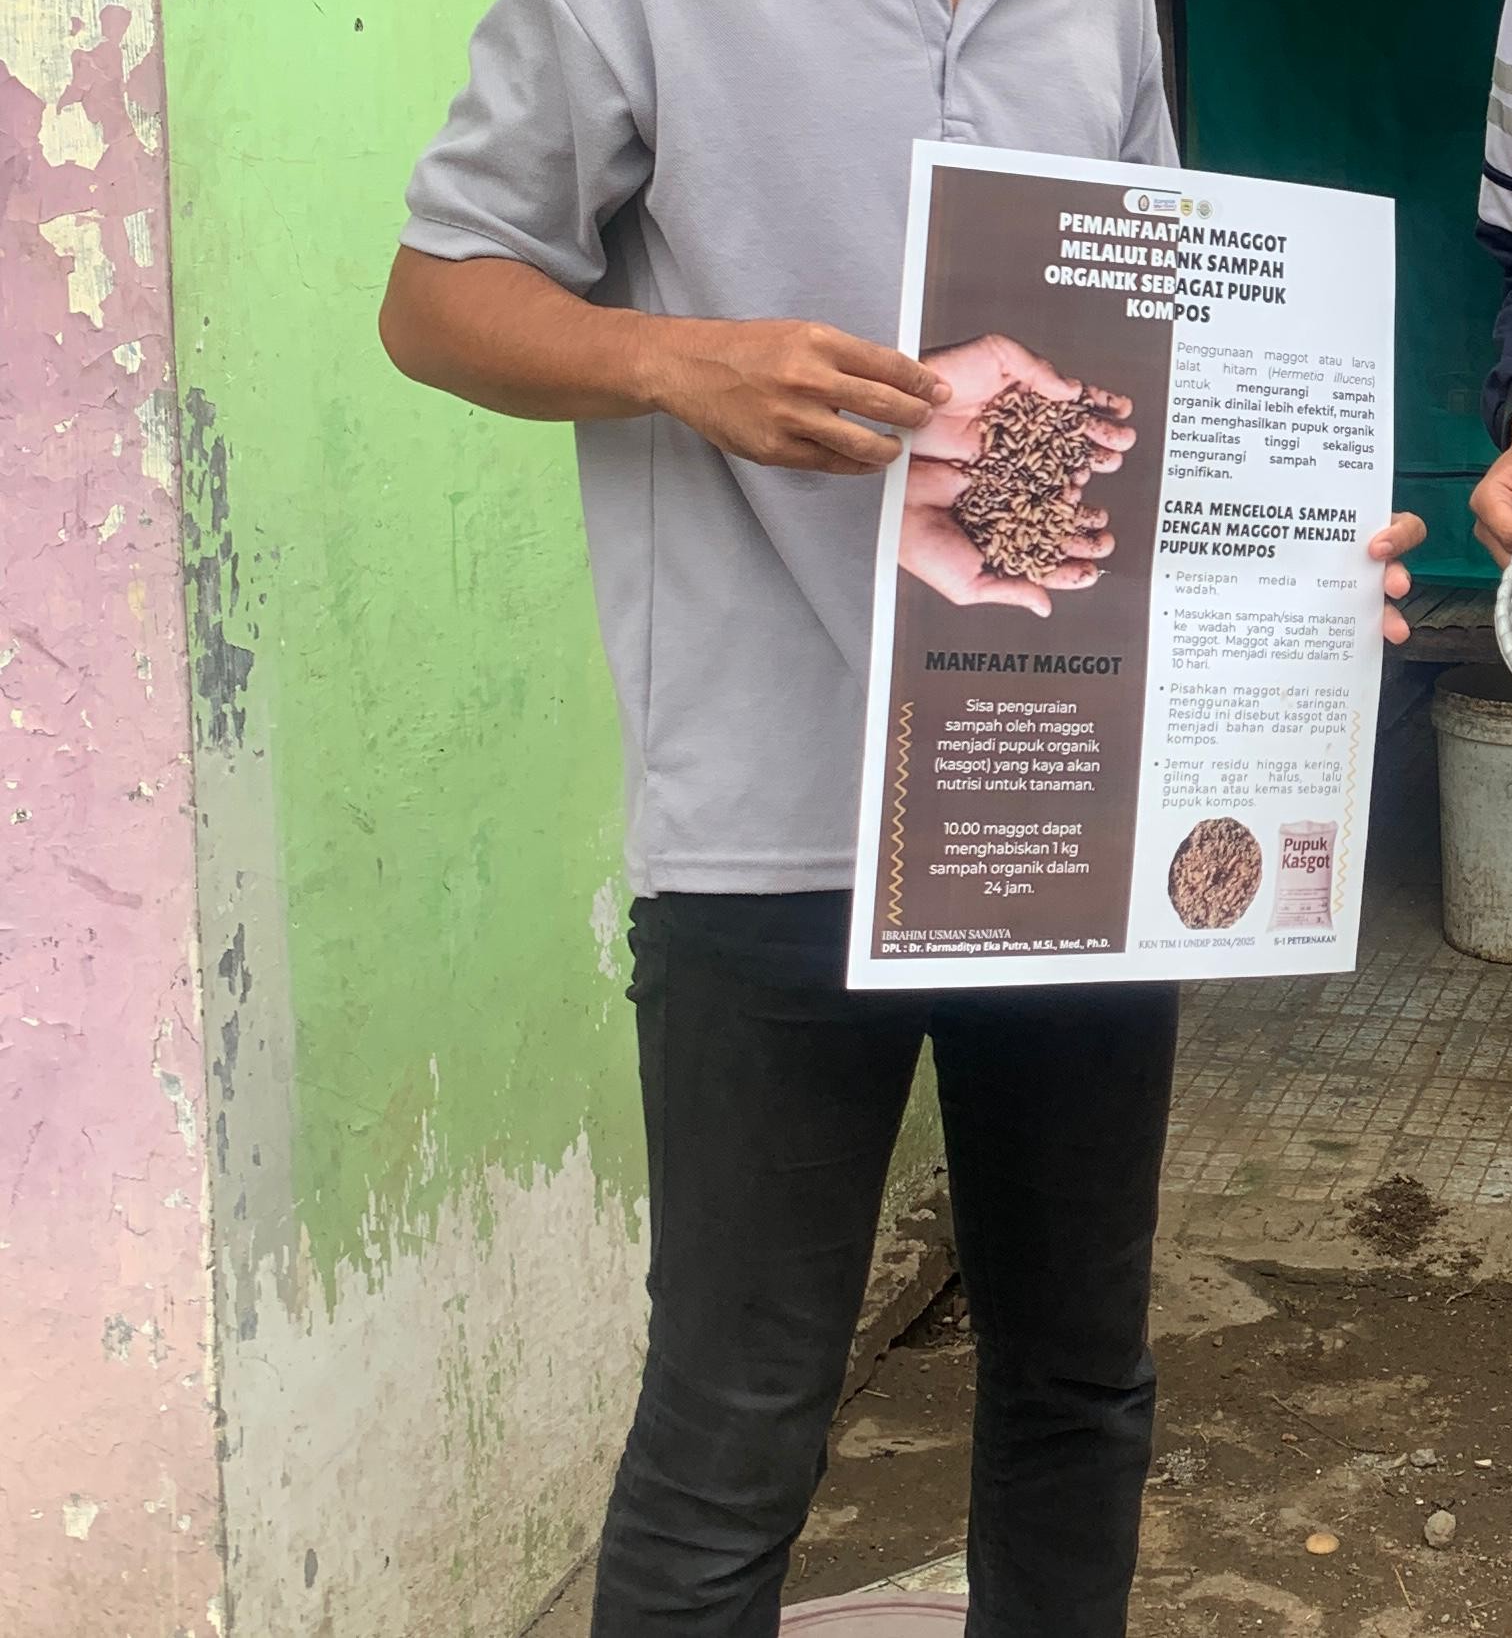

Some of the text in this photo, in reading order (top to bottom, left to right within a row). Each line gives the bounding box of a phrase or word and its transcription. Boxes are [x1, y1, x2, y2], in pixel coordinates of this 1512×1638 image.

[1059, 212, 1286, 253] PEMANFAATAN MAGGOT
[1061, 240, 1284, 278] MELALUI BANK SAMPAH
[1045, 265, 1286, 305] ORGANIK SEBAGAI PUPUK
[1126, 298, 1211, 323] KOMPOS
[1177, 342, 1375, 369] Penggunaan maggot atau larva
[1176, 360, 1375, 388] lalat hitam (Hermetia illucens)
[1175, 379, 1375, 404] untuk mengurangi sampah
[1174, 397, 1374, 419] organik dinilai lebih efektif, murah
[1172, 414, 1374, 437] dan menghasilkan pupuk organik
[1171, 430, 1374, 454] berkualitas tinggi sekaligus
[1170, 448, 1373, 470] mengurangi sampah secara
[1168, 466, 1233, 480] signifikan.
[1165, 500, 1356, 523] CARA MENGELOLA SAMPAH
[1162, 520, 1356, 542] DENGAN MAGGOT MENJADI
[1160, 540, 1275, 558] PUPUK KOMPOS
[1176, 571, 1357, 589] Persiapan media tempat
[1176, 585, 1220, 595] wadah.
[1174, 609, 1355, 624] Masukkan sampah/sisa makanan
[1174, 621, 1355, 637] ke wadah yang sudah berisi
[1173, 635, 1354, 650] maggot. Maggot akan mengurai
[1172, 646, 1339, 661] sampah menjadi residu dalam
[925, 651, 1122, 675] MANFAAT MAGGOT
[1172, 658, 1209, 669] 10 hari.
[1171, 684, 1349, 698] Pisahkan maggot dari residu
[966, 699, 1077, 715] Sisa penguraian
[1170, 697, 1348, 710] menggunakan saringan.
[1169, 709, 1347, 723] Residu ini disebut kasgot dan
[945, 719, 1094, 736] sampah oleh maggot
[1168, 722, 1346, 735] menjadi bahan dasar pupuk
[937, 738, 1099, 755] menjadi pupuk organik
[1167, 734, 1219, 746] kompos.
[935, 757, 1100, 774] (kasgot) yang kaya akan
[1164, 759, 1343, 772] Jemur residu hingga kering,
[937, 778, 1095, 792] nutrisi untuk tanaman.
[1164, 772, 1341, 783] giling agar halus, lalu
[1163, 785, 1341, 796] gunakan atau kemas sebagai
[1162, 797, 1256, 809] pupuk kompos.
[944, 822, 1082, 838] 10.00 maggot dapat
[945, 842, 1079, 857] menghabiskan 1 kg
[1283, 837, 1328, 854] Pupuk
[929, 861, 1089, 877] sampah organik dalam
[1282, 854, 1330, 873] Kasgot
[984, 881, 1034, 897] 24 jam.
[882, 929, 1011, 940] IBRAHIM USMAN SANJAYA
[1288, 935, 1337, 945] PETERNAKAN
[882, 944, 902, 952] DPL
[909, 943, 924, 952] Dr.
[926, 942, 981, 953] Farmaditya
[983, 942, 1000, 951] Eka
[1002, 941, 1030, 951] Putra,
[1087, 939, 1110, 948] Ph.D.
[1138, 940, 1158, 950] KKN
[1160, 940, 1176, 948] TIM
[1184, 939, 1210, 948] UNDIP
